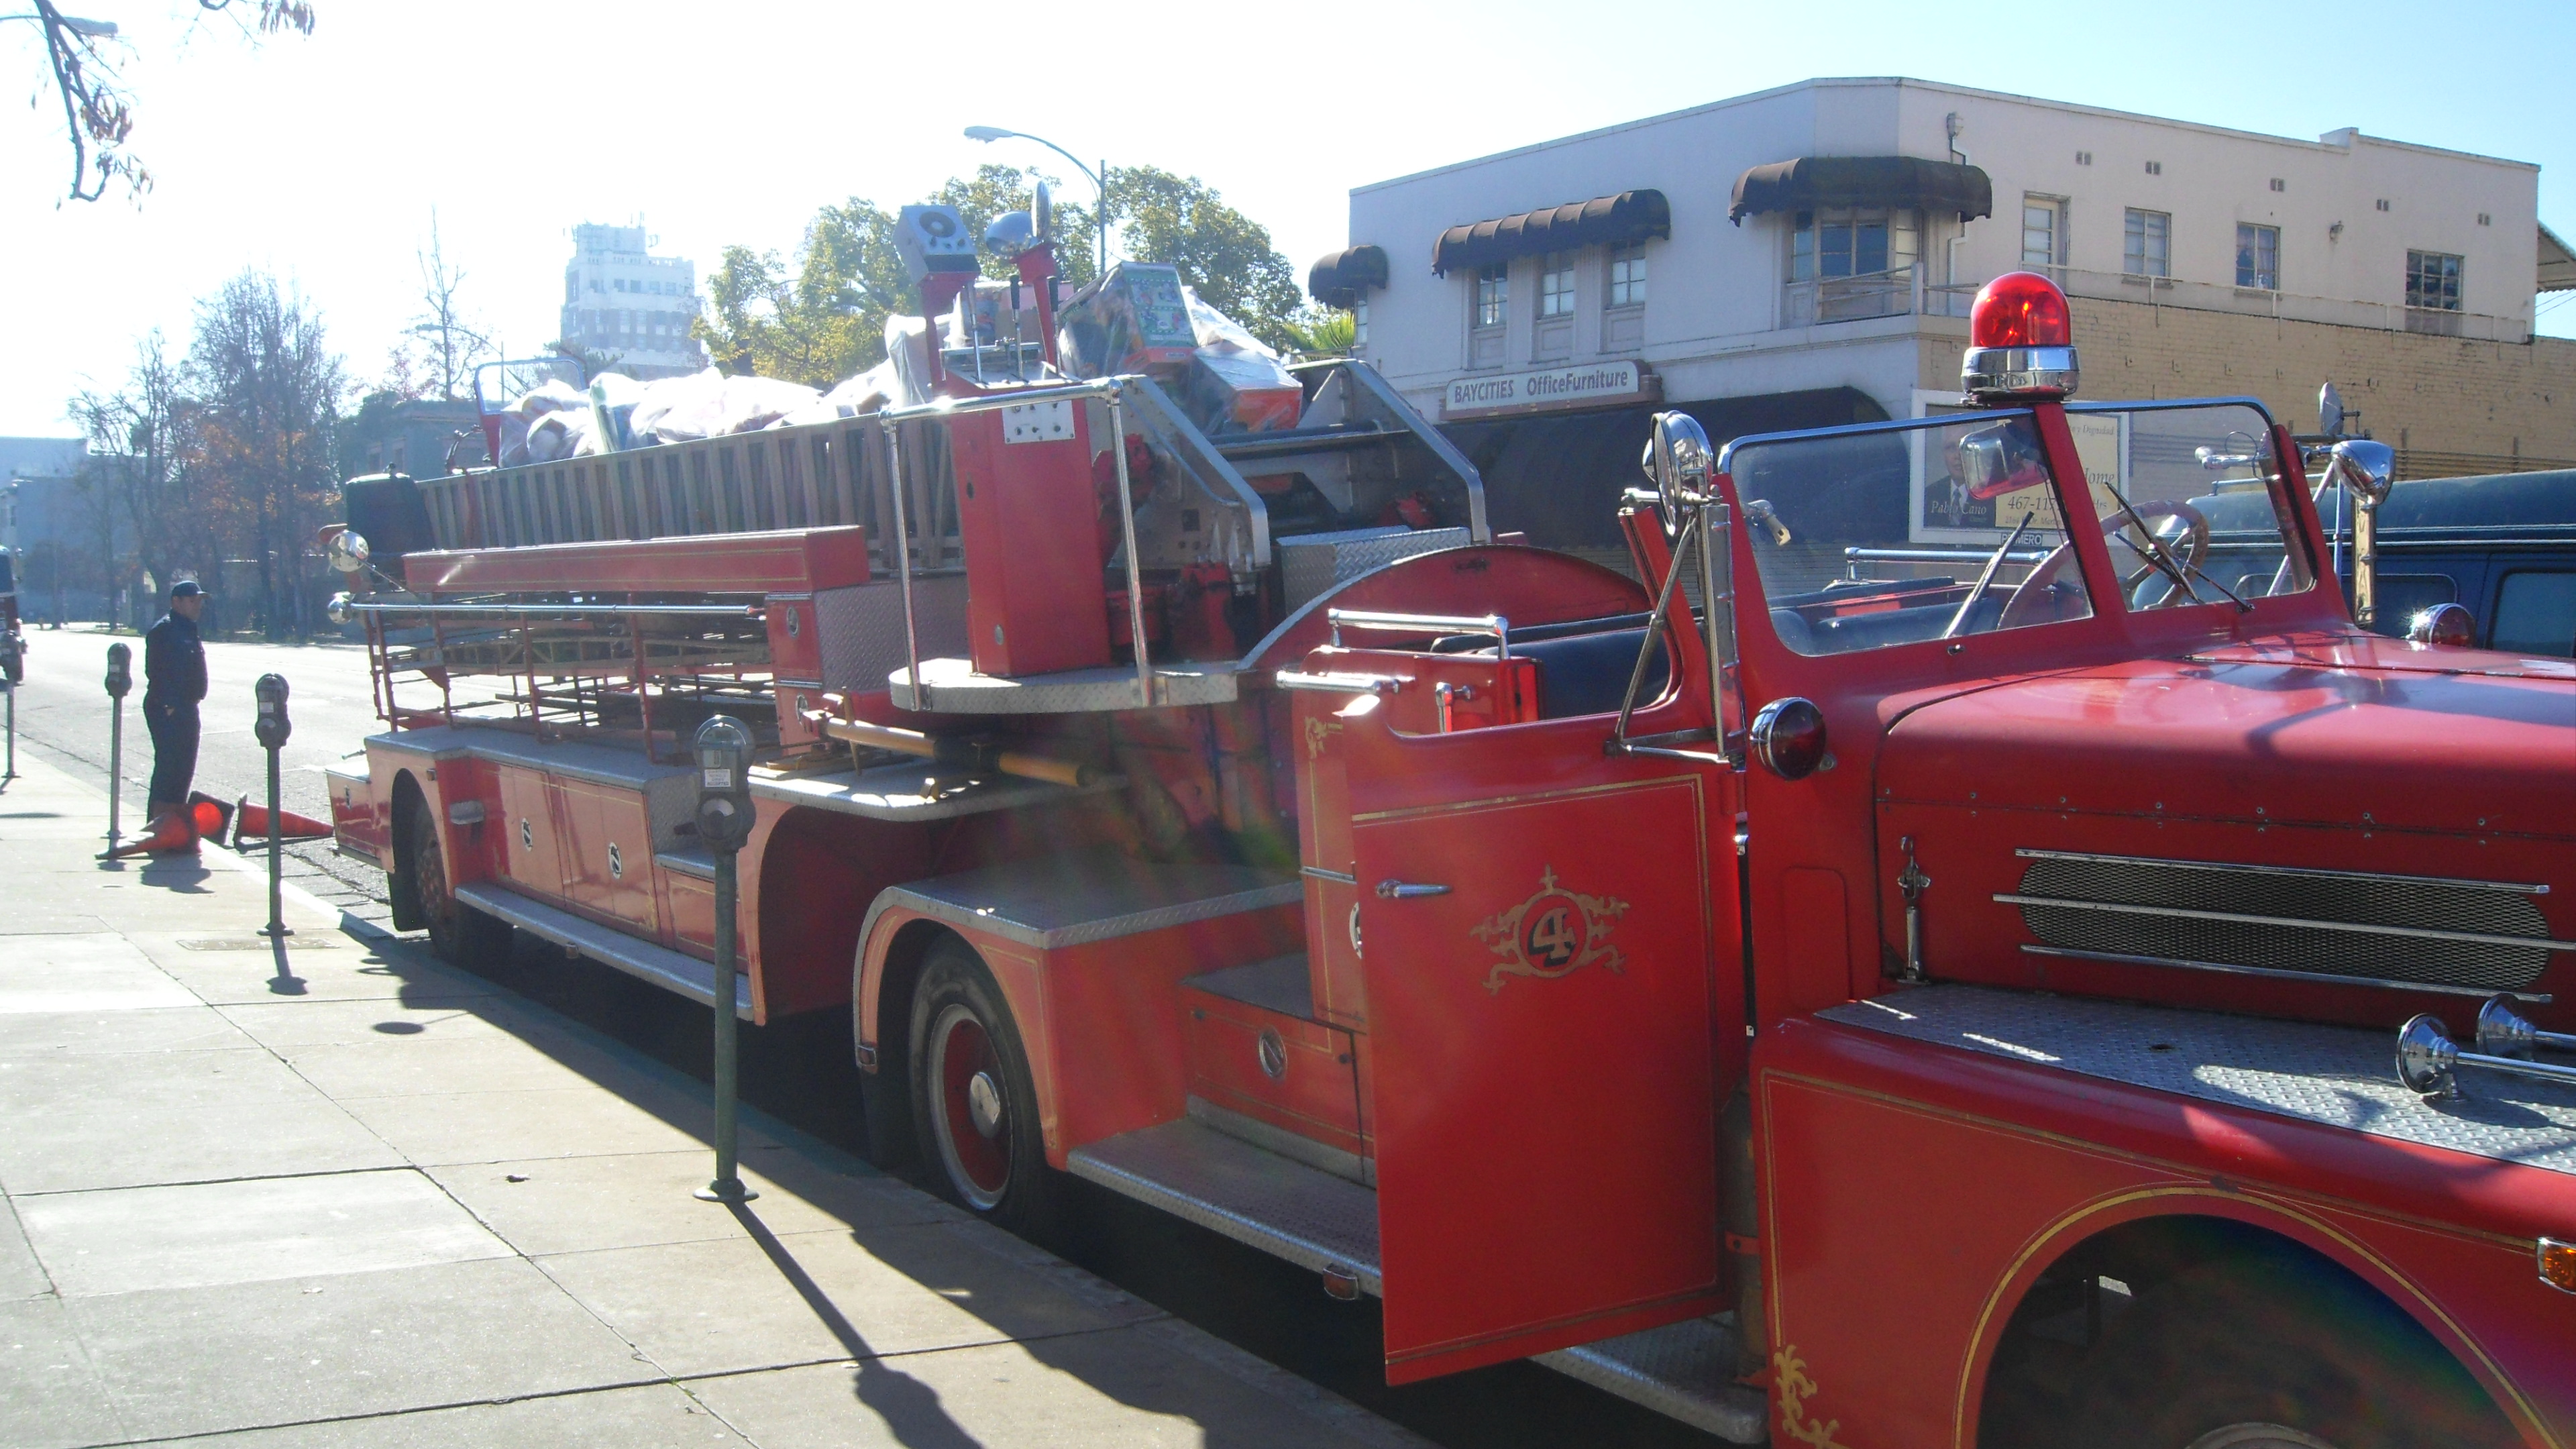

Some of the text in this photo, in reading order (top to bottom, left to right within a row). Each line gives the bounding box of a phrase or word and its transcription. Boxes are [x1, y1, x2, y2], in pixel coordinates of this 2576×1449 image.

[1454, 380, 1513, 402] BAYCITIES
[1931, 501, 1987, 515] Pablo Cano
[2008, 496, 2059, 510] 467-117
[2002, 534, 2042, 545] PMERO
[1530, 907, 1576, 964] 4
